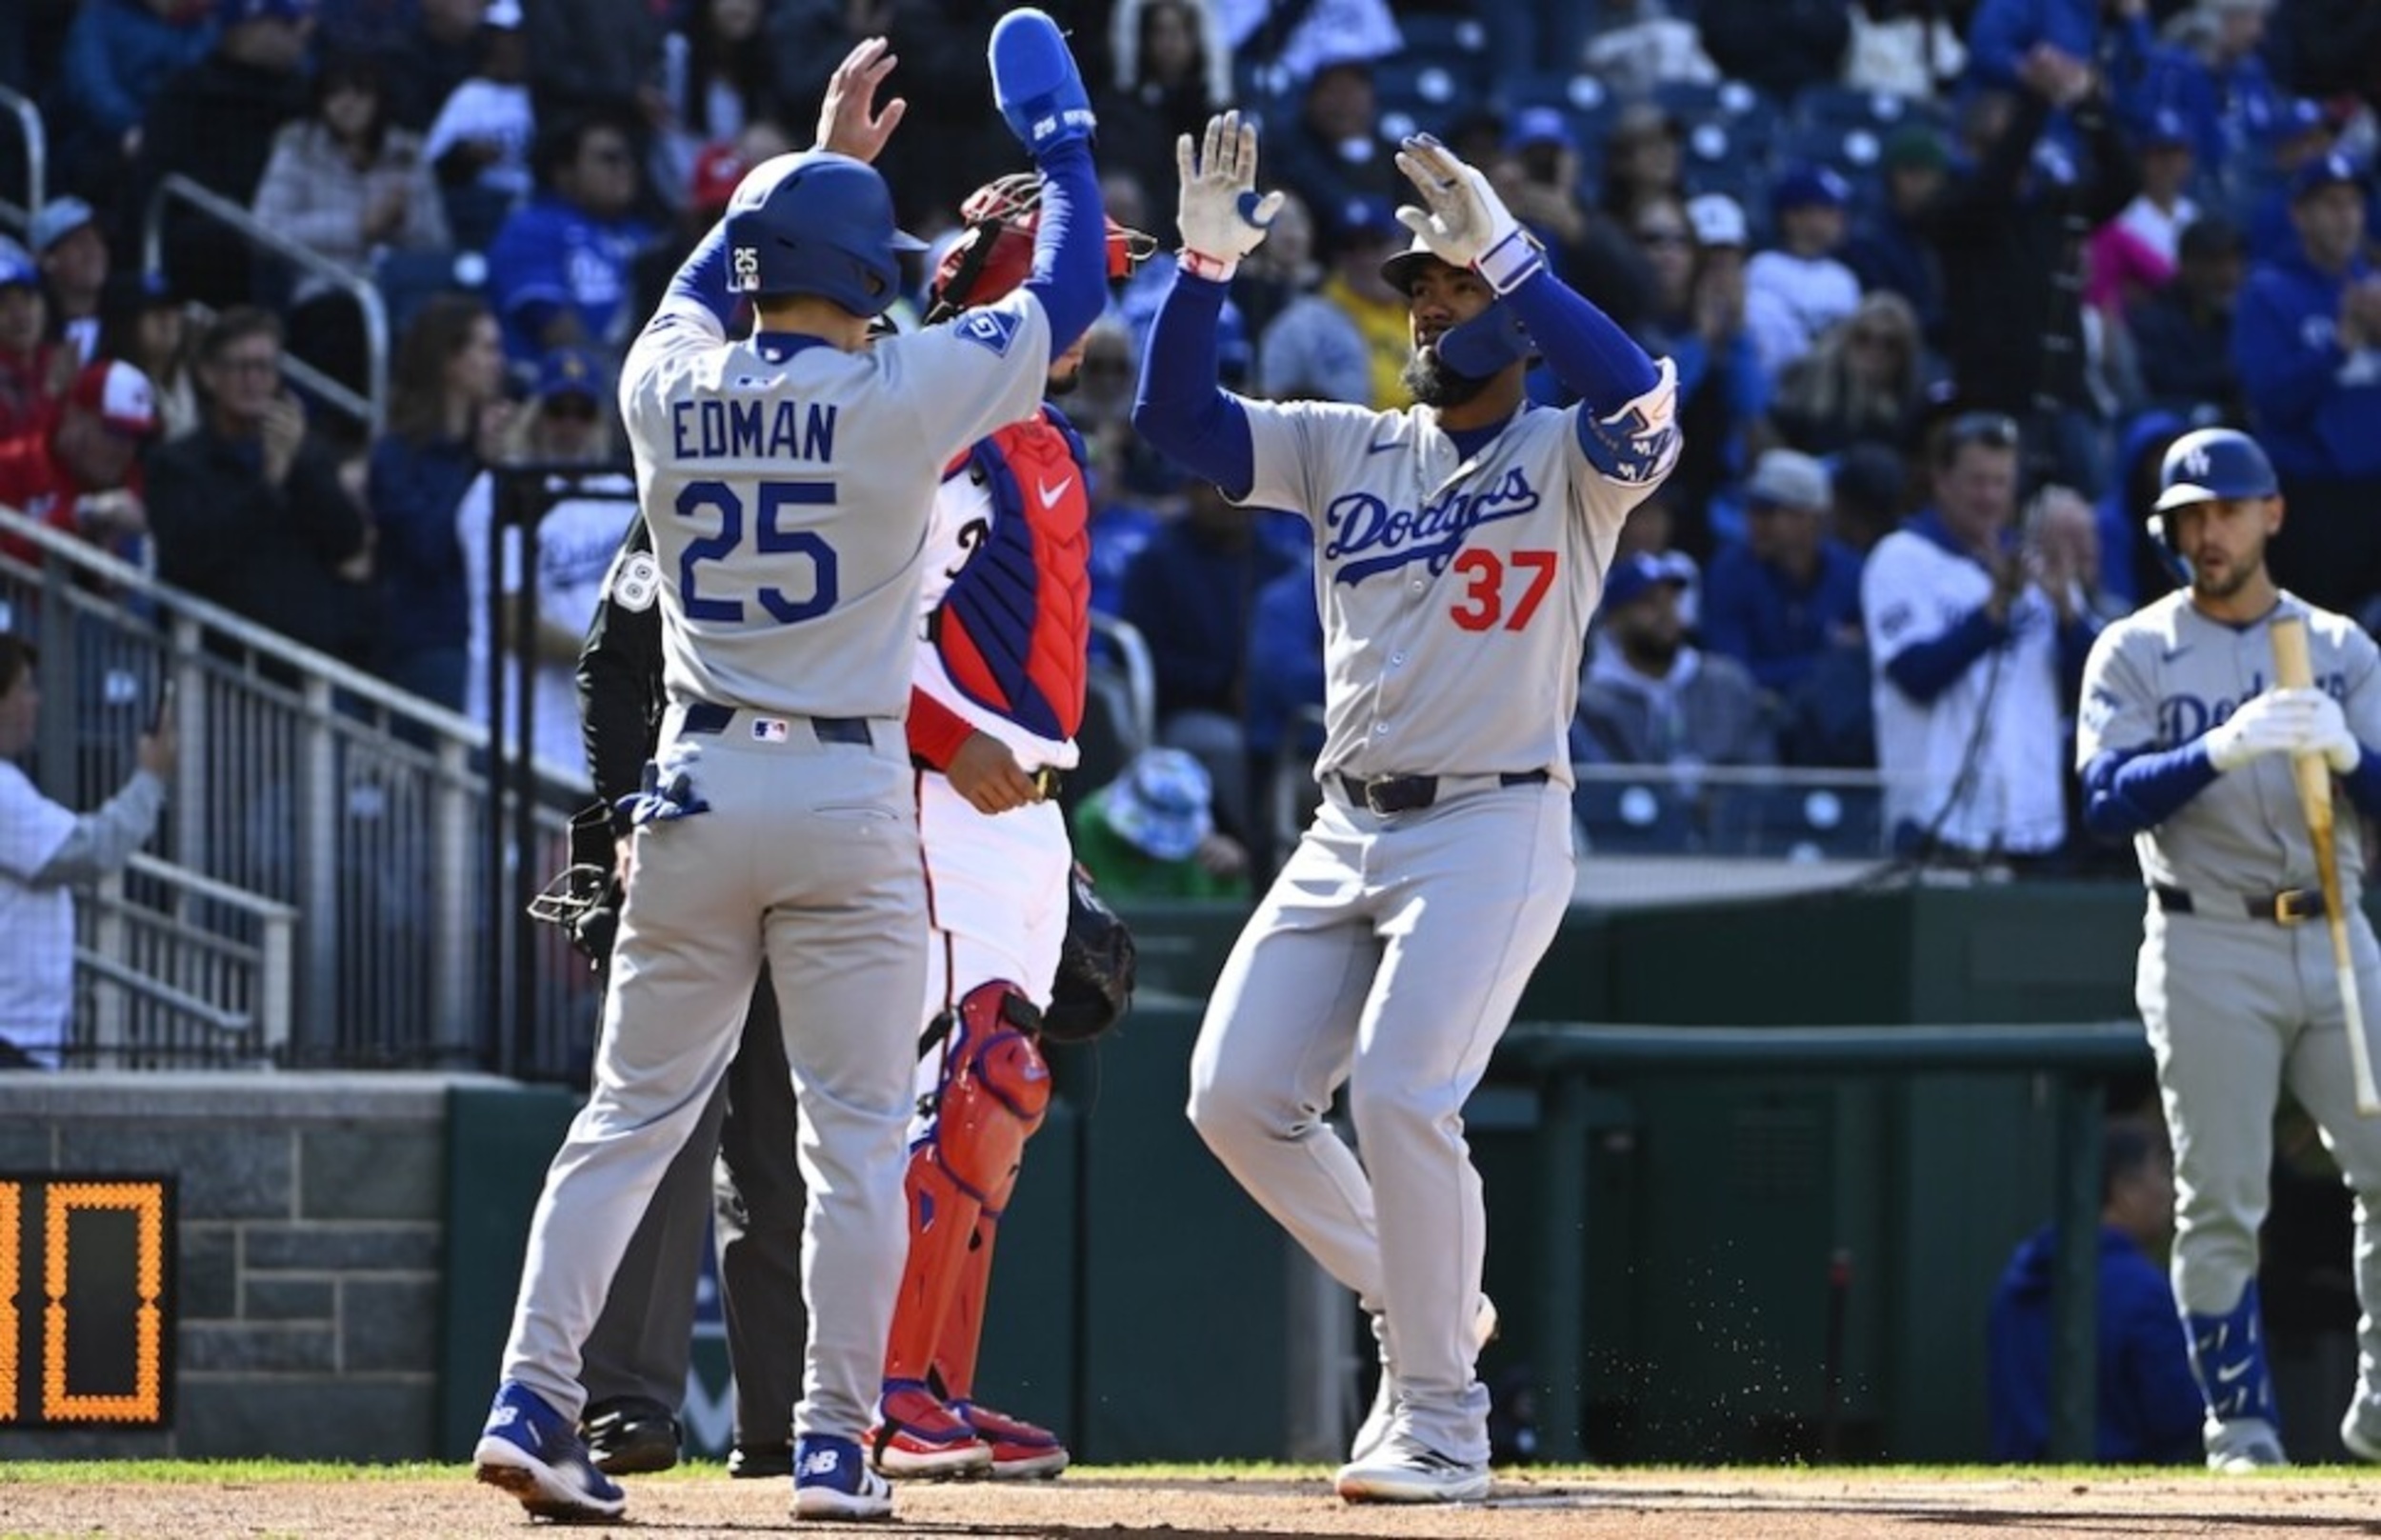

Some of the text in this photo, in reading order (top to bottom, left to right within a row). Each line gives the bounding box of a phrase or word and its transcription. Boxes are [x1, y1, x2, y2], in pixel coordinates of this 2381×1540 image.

[734, 247, 759, 274] 25
[672, 398, 838, 464] EDMAN
[674, 481, 839, 625] 25
[1450, 548, 1558, 632] 37
[0, 1181, 162, 1423] 0
[801, 1450, 839, 1478] NB
